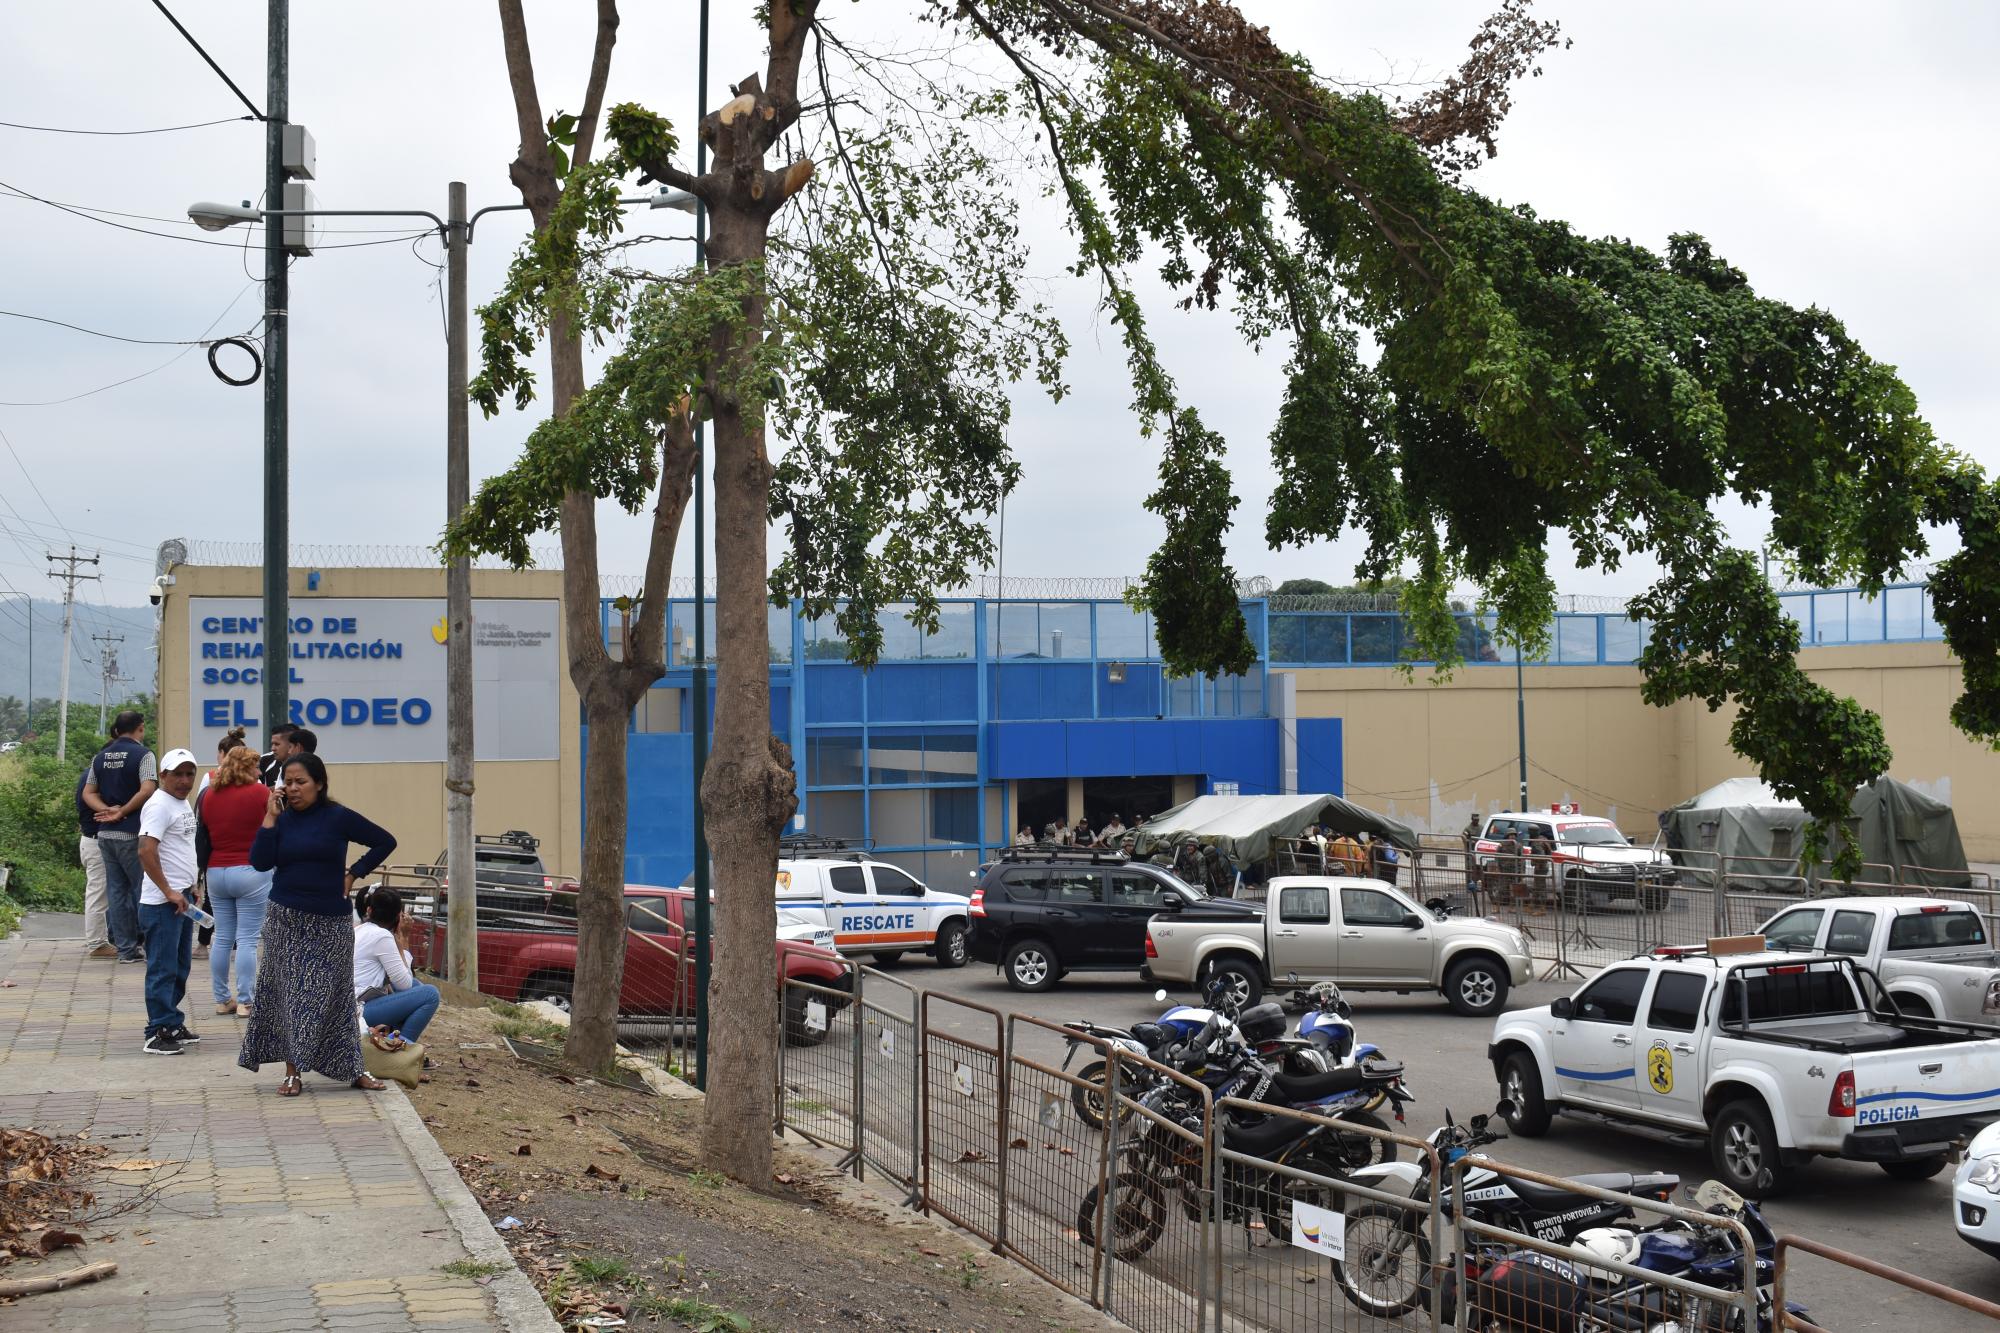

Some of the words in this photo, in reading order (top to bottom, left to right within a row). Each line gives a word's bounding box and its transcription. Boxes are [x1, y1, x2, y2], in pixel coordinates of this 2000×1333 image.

[202, 617, 314, 634] CENO
[323, 618, 357, 634] DE
[202, 639, 402, 659] REHALITACIÓN
[202, 668, 304, 684] SOCL
[203, 699, 259, 727] EL
[842, 914, 914, 931] RESCATE
[1859, 1104, 1919, 1124] POLICIA
[1465, 1187, 1505, 1201] OLICIA
[1533, 1215, 1562, 1229] DISTRITO
[1562, 1204, 1601, 1222] PORTOVIEJO
[1537, 1224, 1566, 1241] GOM
